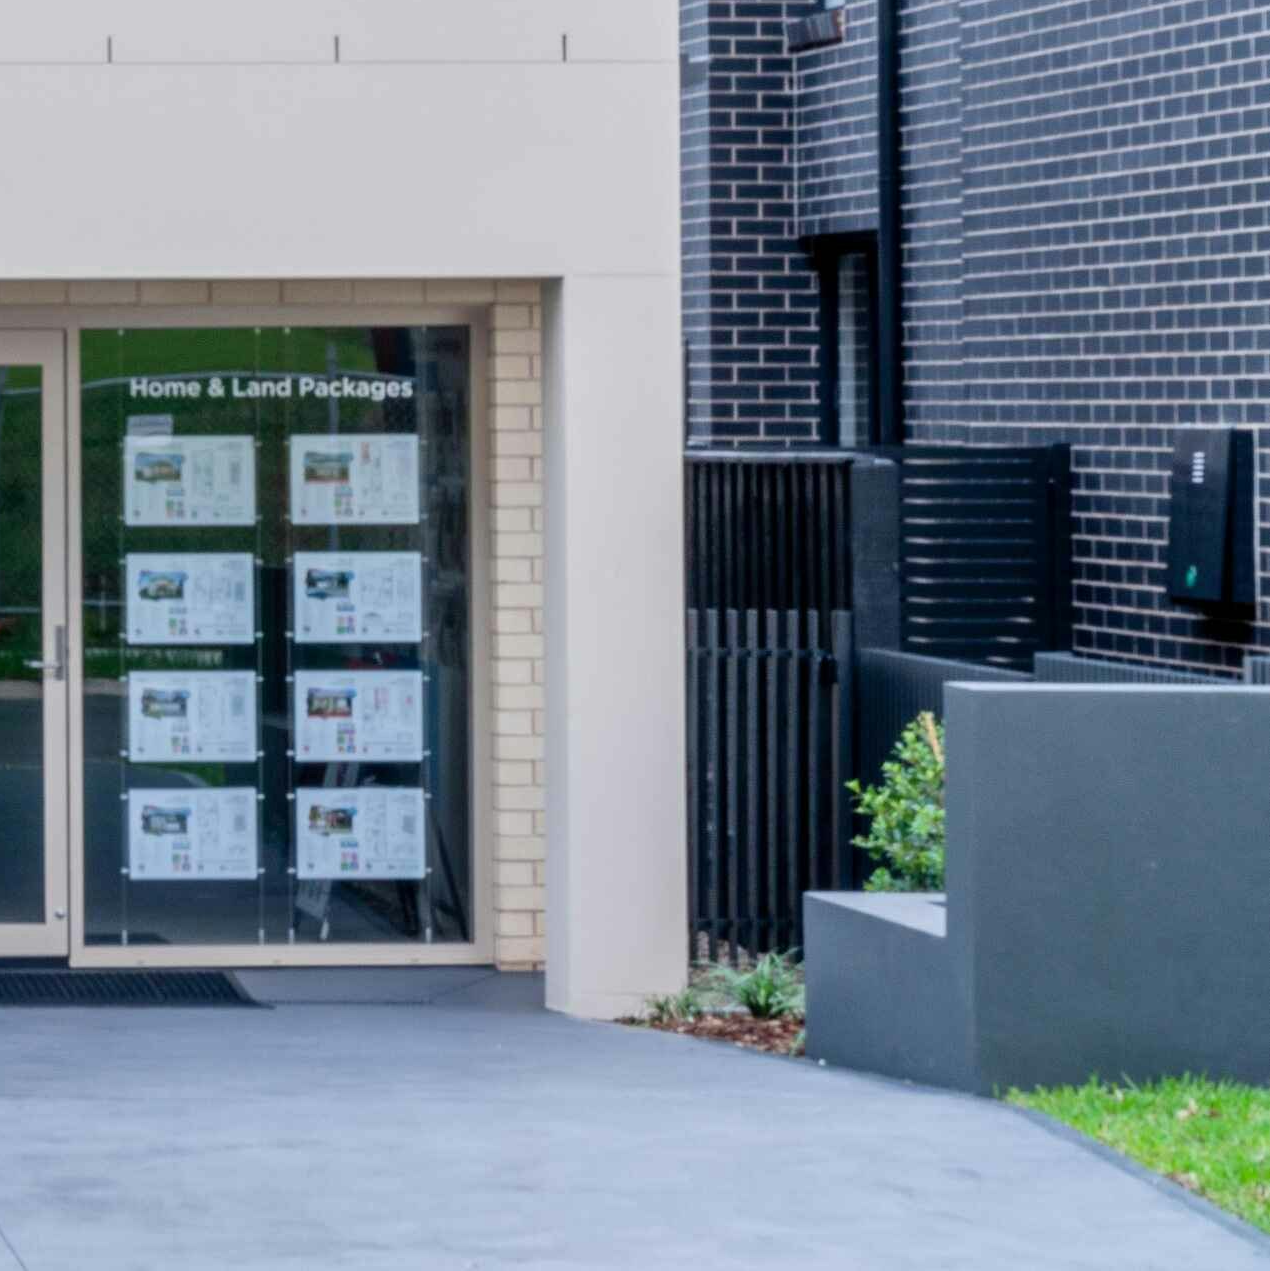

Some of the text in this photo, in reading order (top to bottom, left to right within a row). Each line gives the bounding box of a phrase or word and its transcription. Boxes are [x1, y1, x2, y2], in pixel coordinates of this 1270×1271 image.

[129, 378, 413, 401] Home & Land Packages
